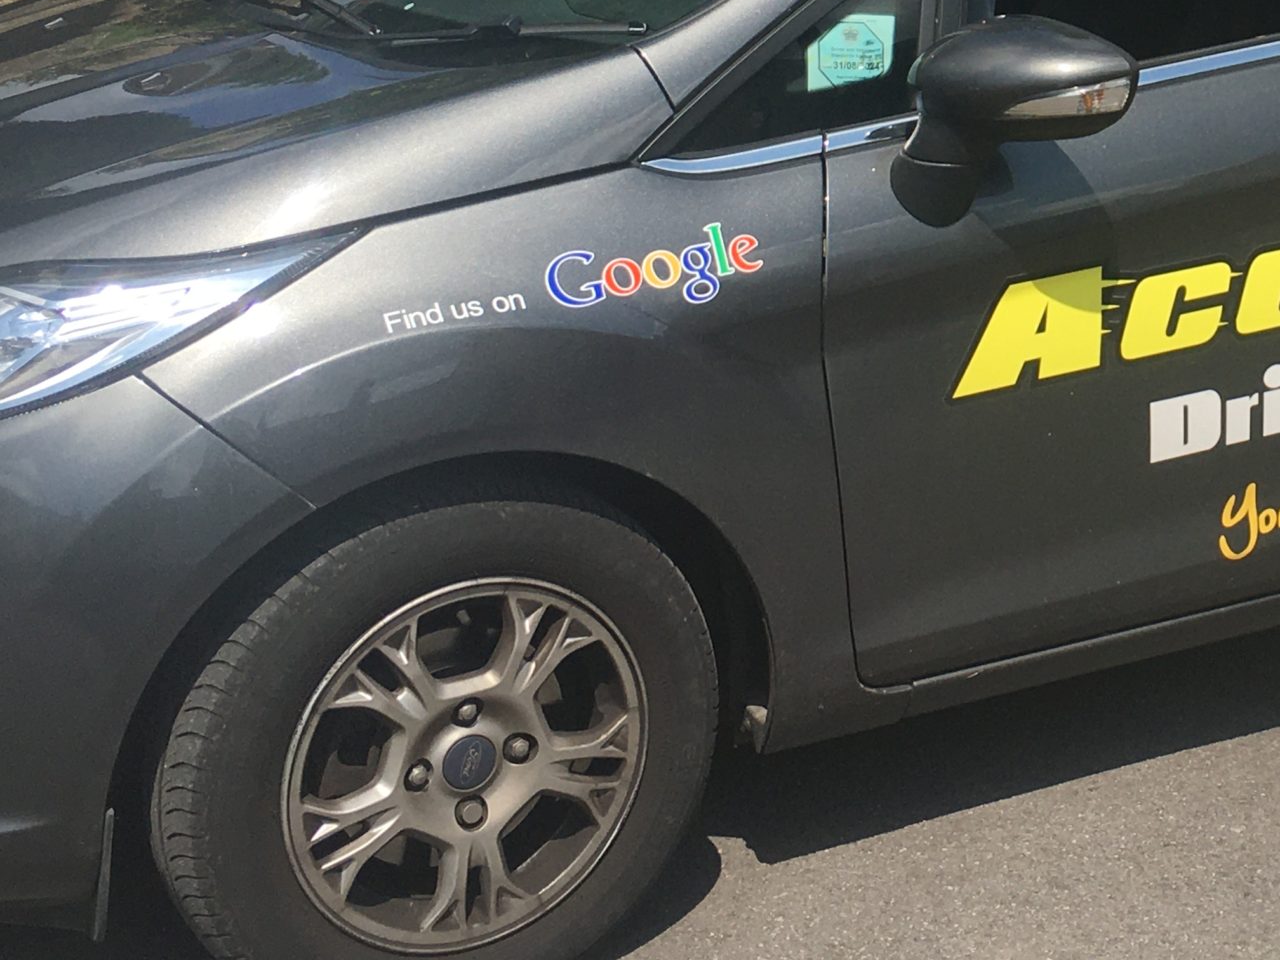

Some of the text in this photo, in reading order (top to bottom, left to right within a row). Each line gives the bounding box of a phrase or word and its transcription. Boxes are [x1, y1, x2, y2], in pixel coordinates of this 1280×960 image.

[383, 222, 763, 333] Find us on Google
